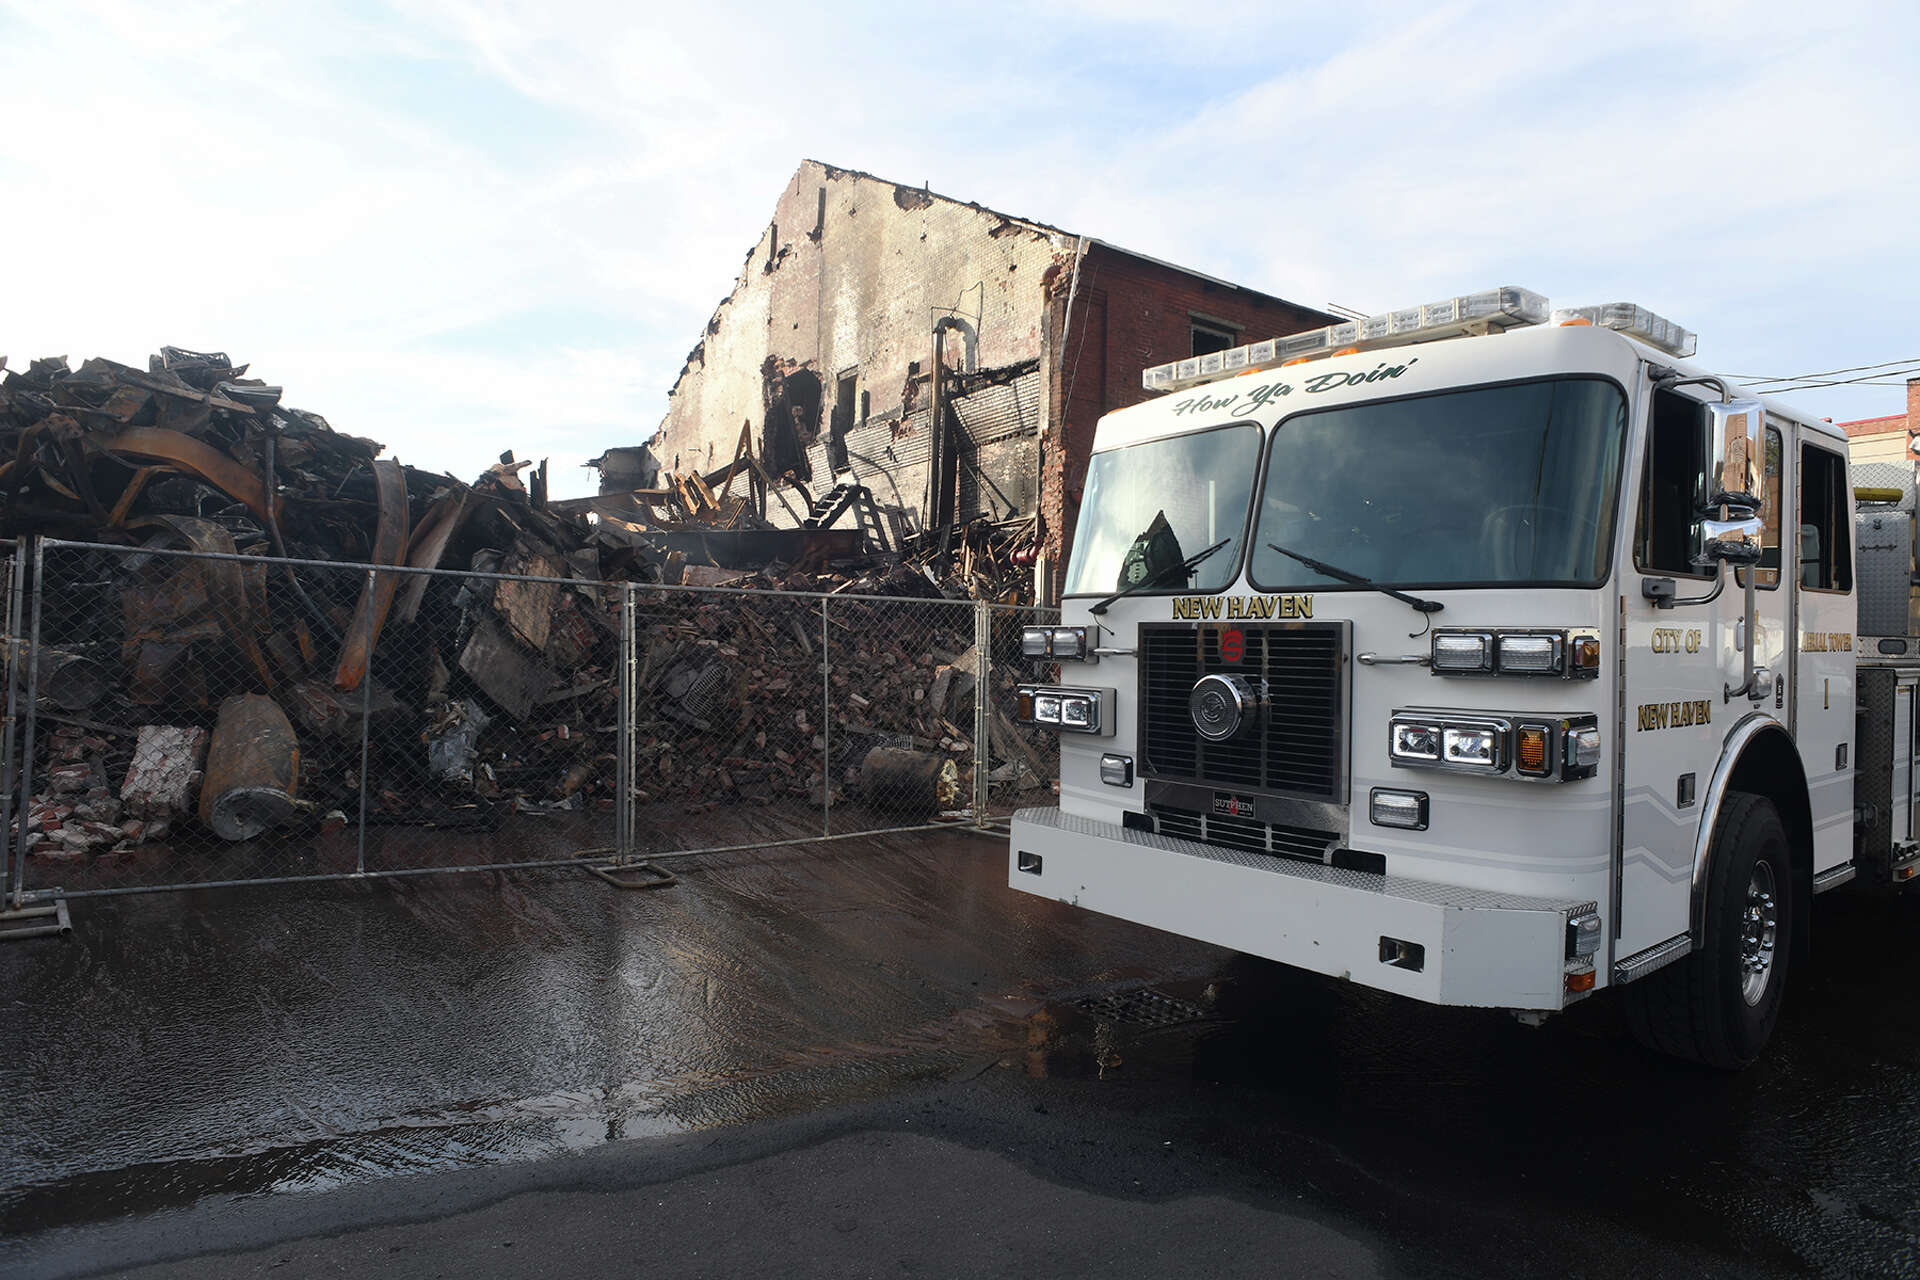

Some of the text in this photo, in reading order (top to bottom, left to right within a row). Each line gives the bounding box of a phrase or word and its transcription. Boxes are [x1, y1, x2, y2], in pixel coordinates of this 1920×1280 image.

[1173, 358, 1418, 417] How Ya Doin'
[1172, 594, 1313, 619] NEW HAVEN
[1651, 628, 1701, 653] CITY OF
[1801, 632, 1852, 652] AERIAL TOWER
[1637, 700, 1711, 732] NEW HAVEN
[1215, 798, 1253, 812] SUTPHEN
